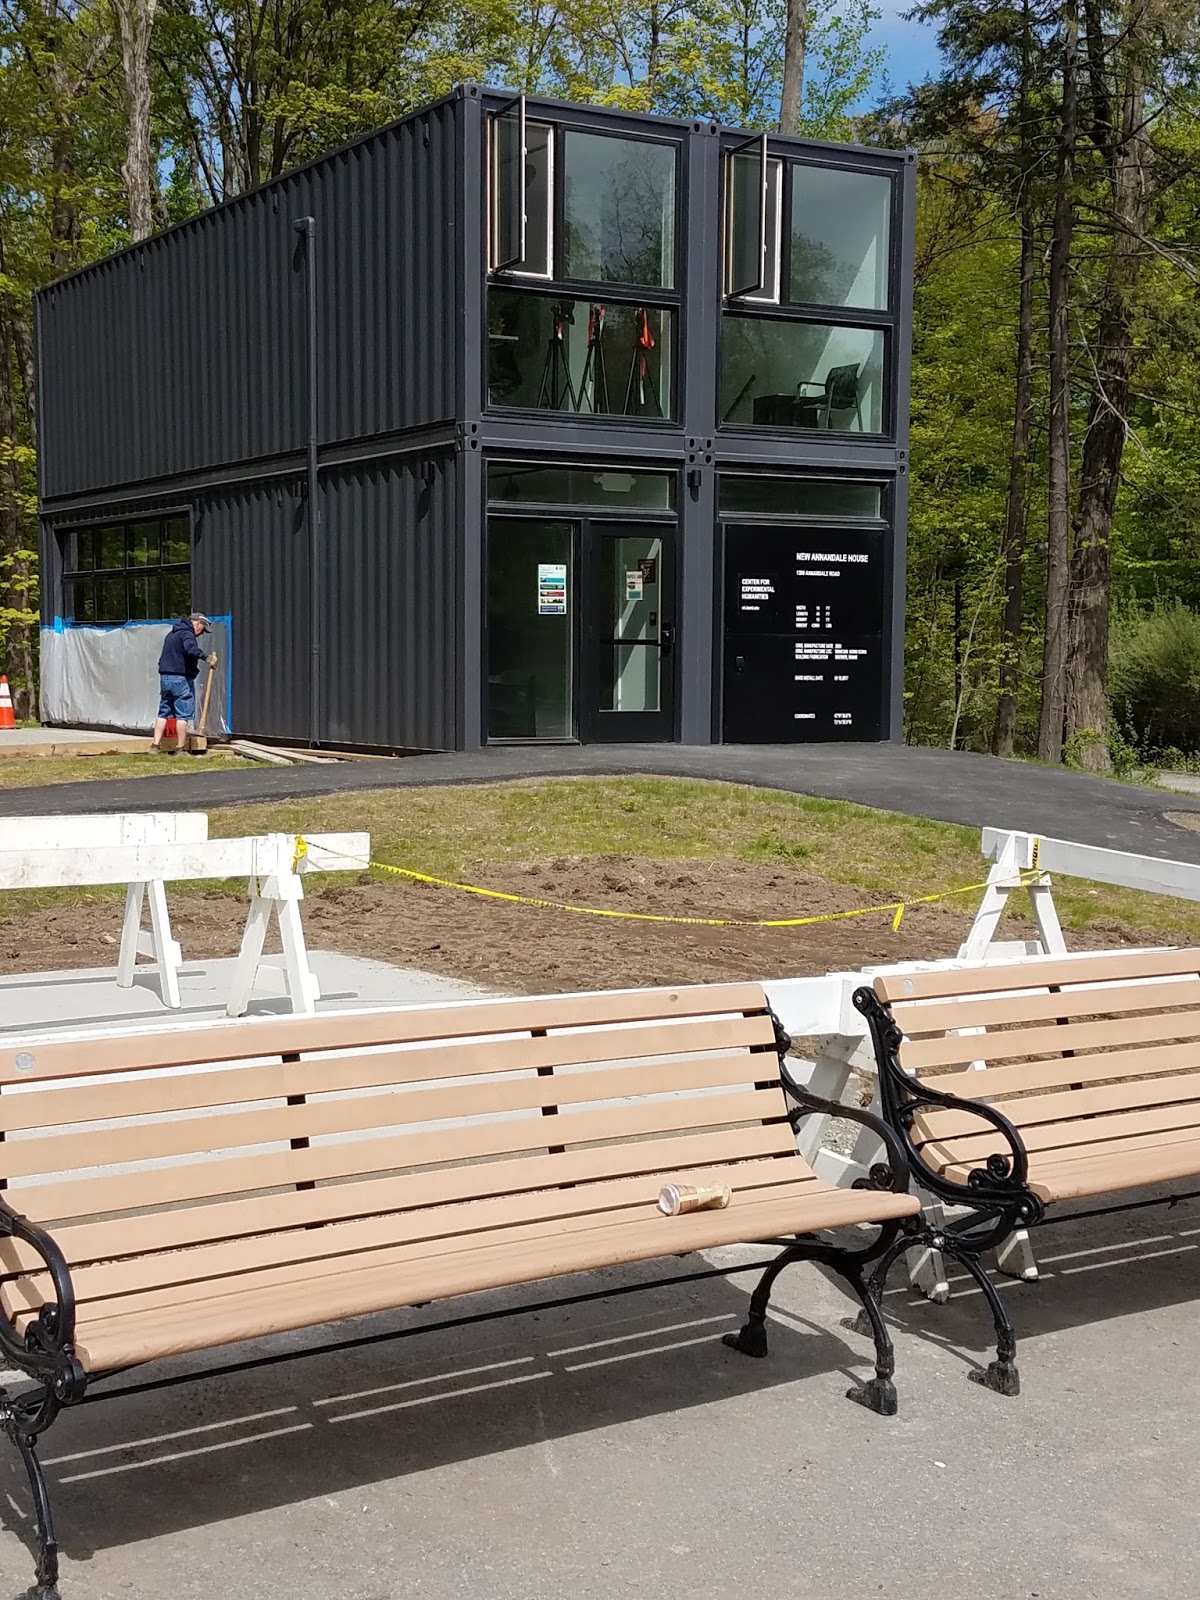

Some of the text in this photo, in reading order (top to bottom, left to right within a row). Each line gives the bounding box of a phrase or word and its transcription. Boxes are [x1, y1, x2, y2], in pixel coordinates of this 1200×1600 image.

[796, 552, 869, 563] NEW ANNANDALE HOUSE
[760, 578, 771, 586] FOR
